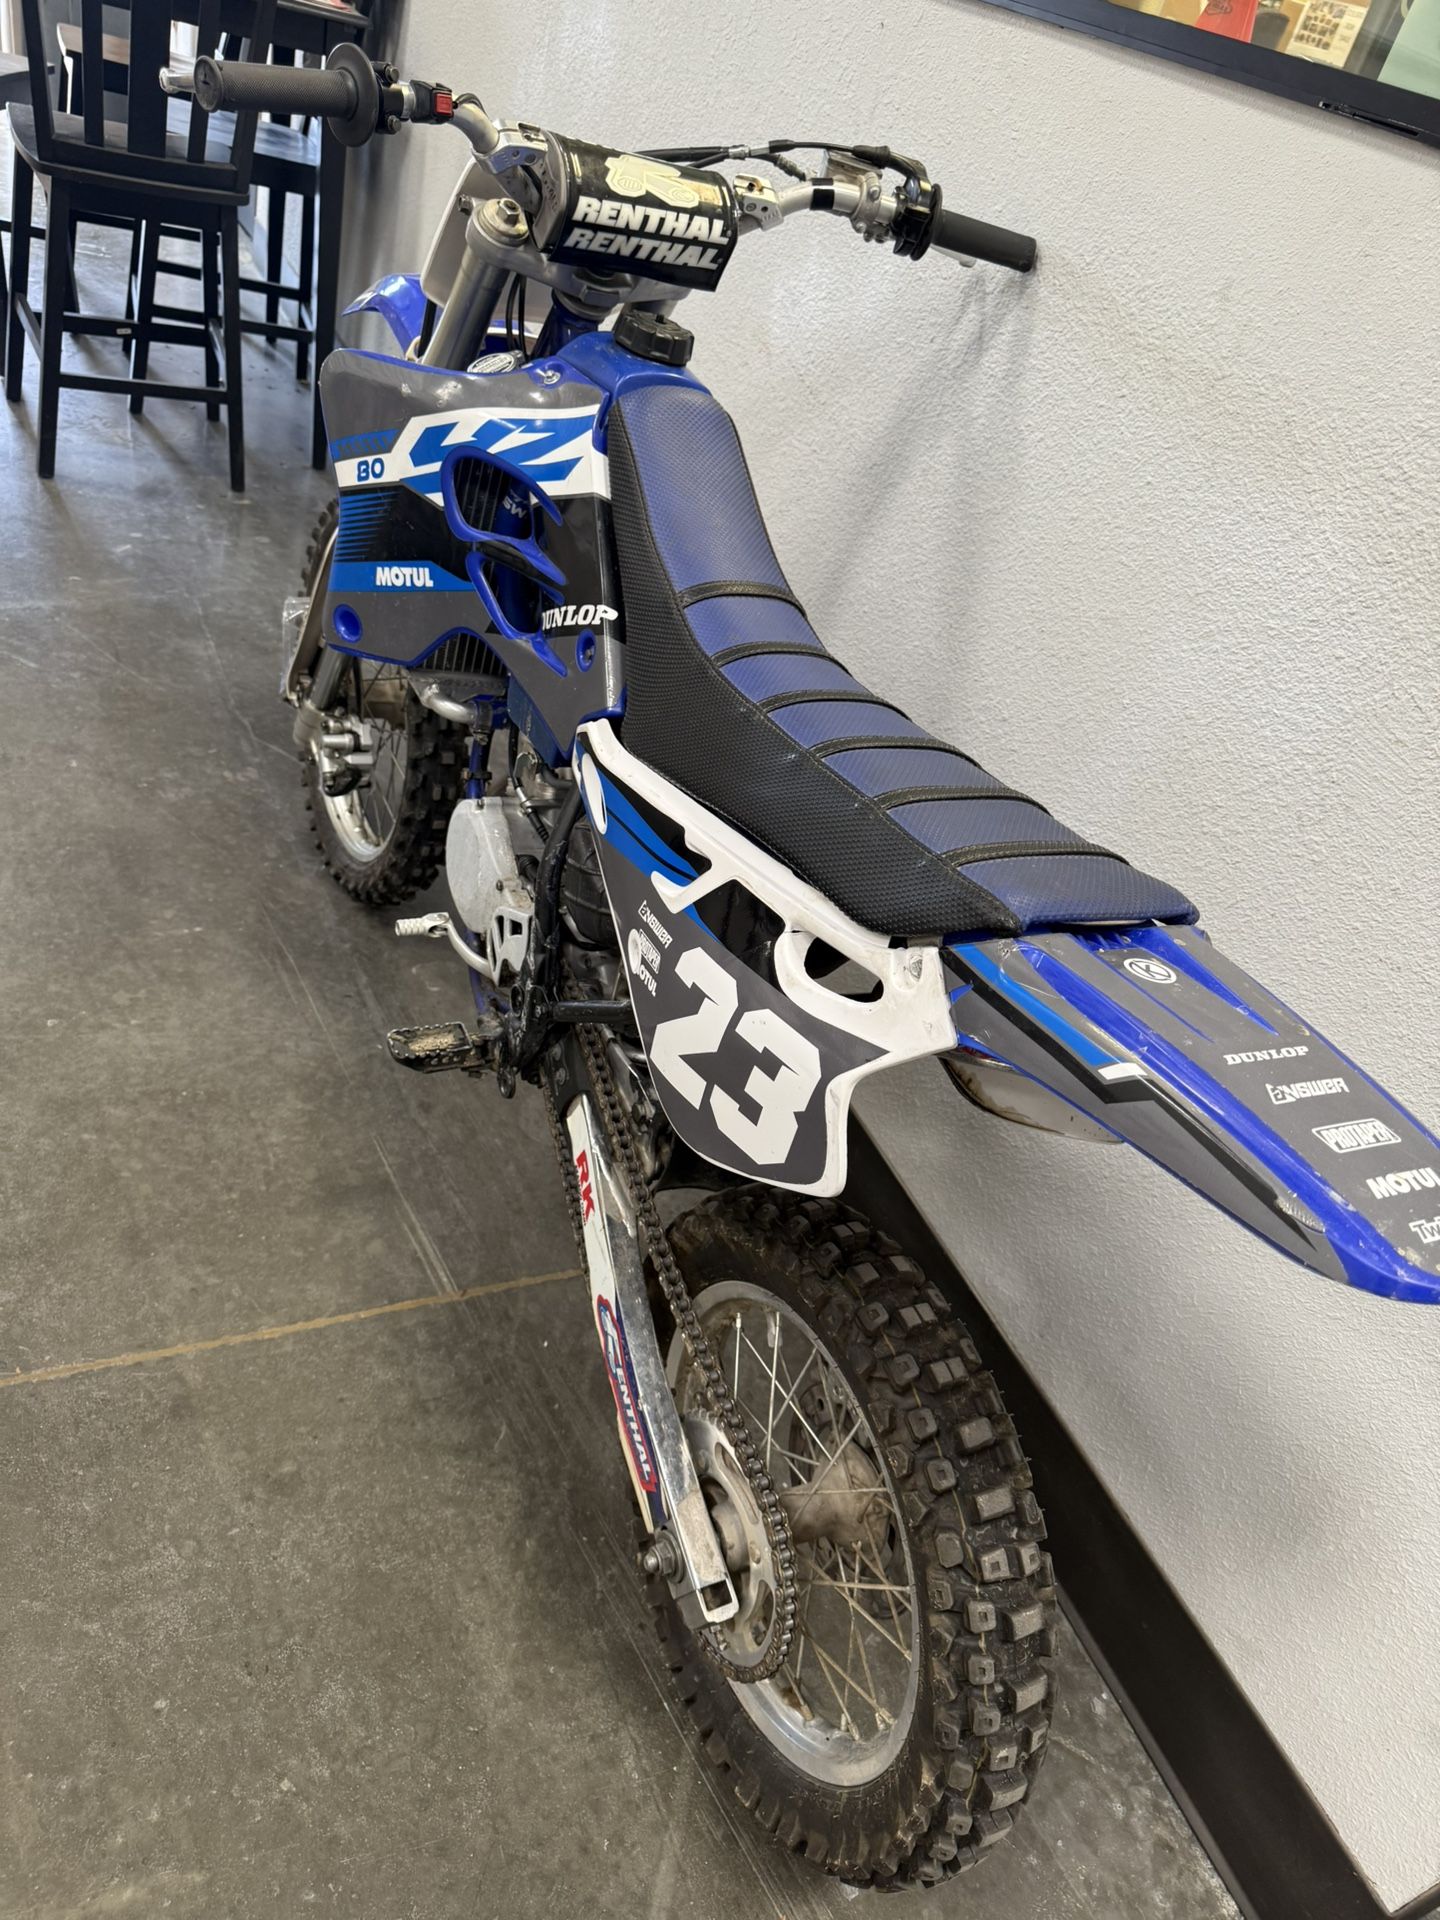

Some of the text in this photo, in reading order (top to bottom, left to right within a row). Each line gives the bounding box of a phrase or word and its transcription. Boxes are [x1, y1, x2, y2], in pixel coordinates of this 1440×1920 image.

[572, 196, 729, 245] RENTHAL
[563, 228, 721, 270] RENTHAL
[376, 566, 434, 588] MOTUL
[639, 964, 658, 997] OTUL
[650, 946, 822, 1165] 23
[1223, 1045, 1309, 1066] DUNLOP
[1318, 1121, 1395, 1150] PROTAPER
[576, 1151, 596, 1223] RK
[1409, 1216, 1440, 1244] Tw
